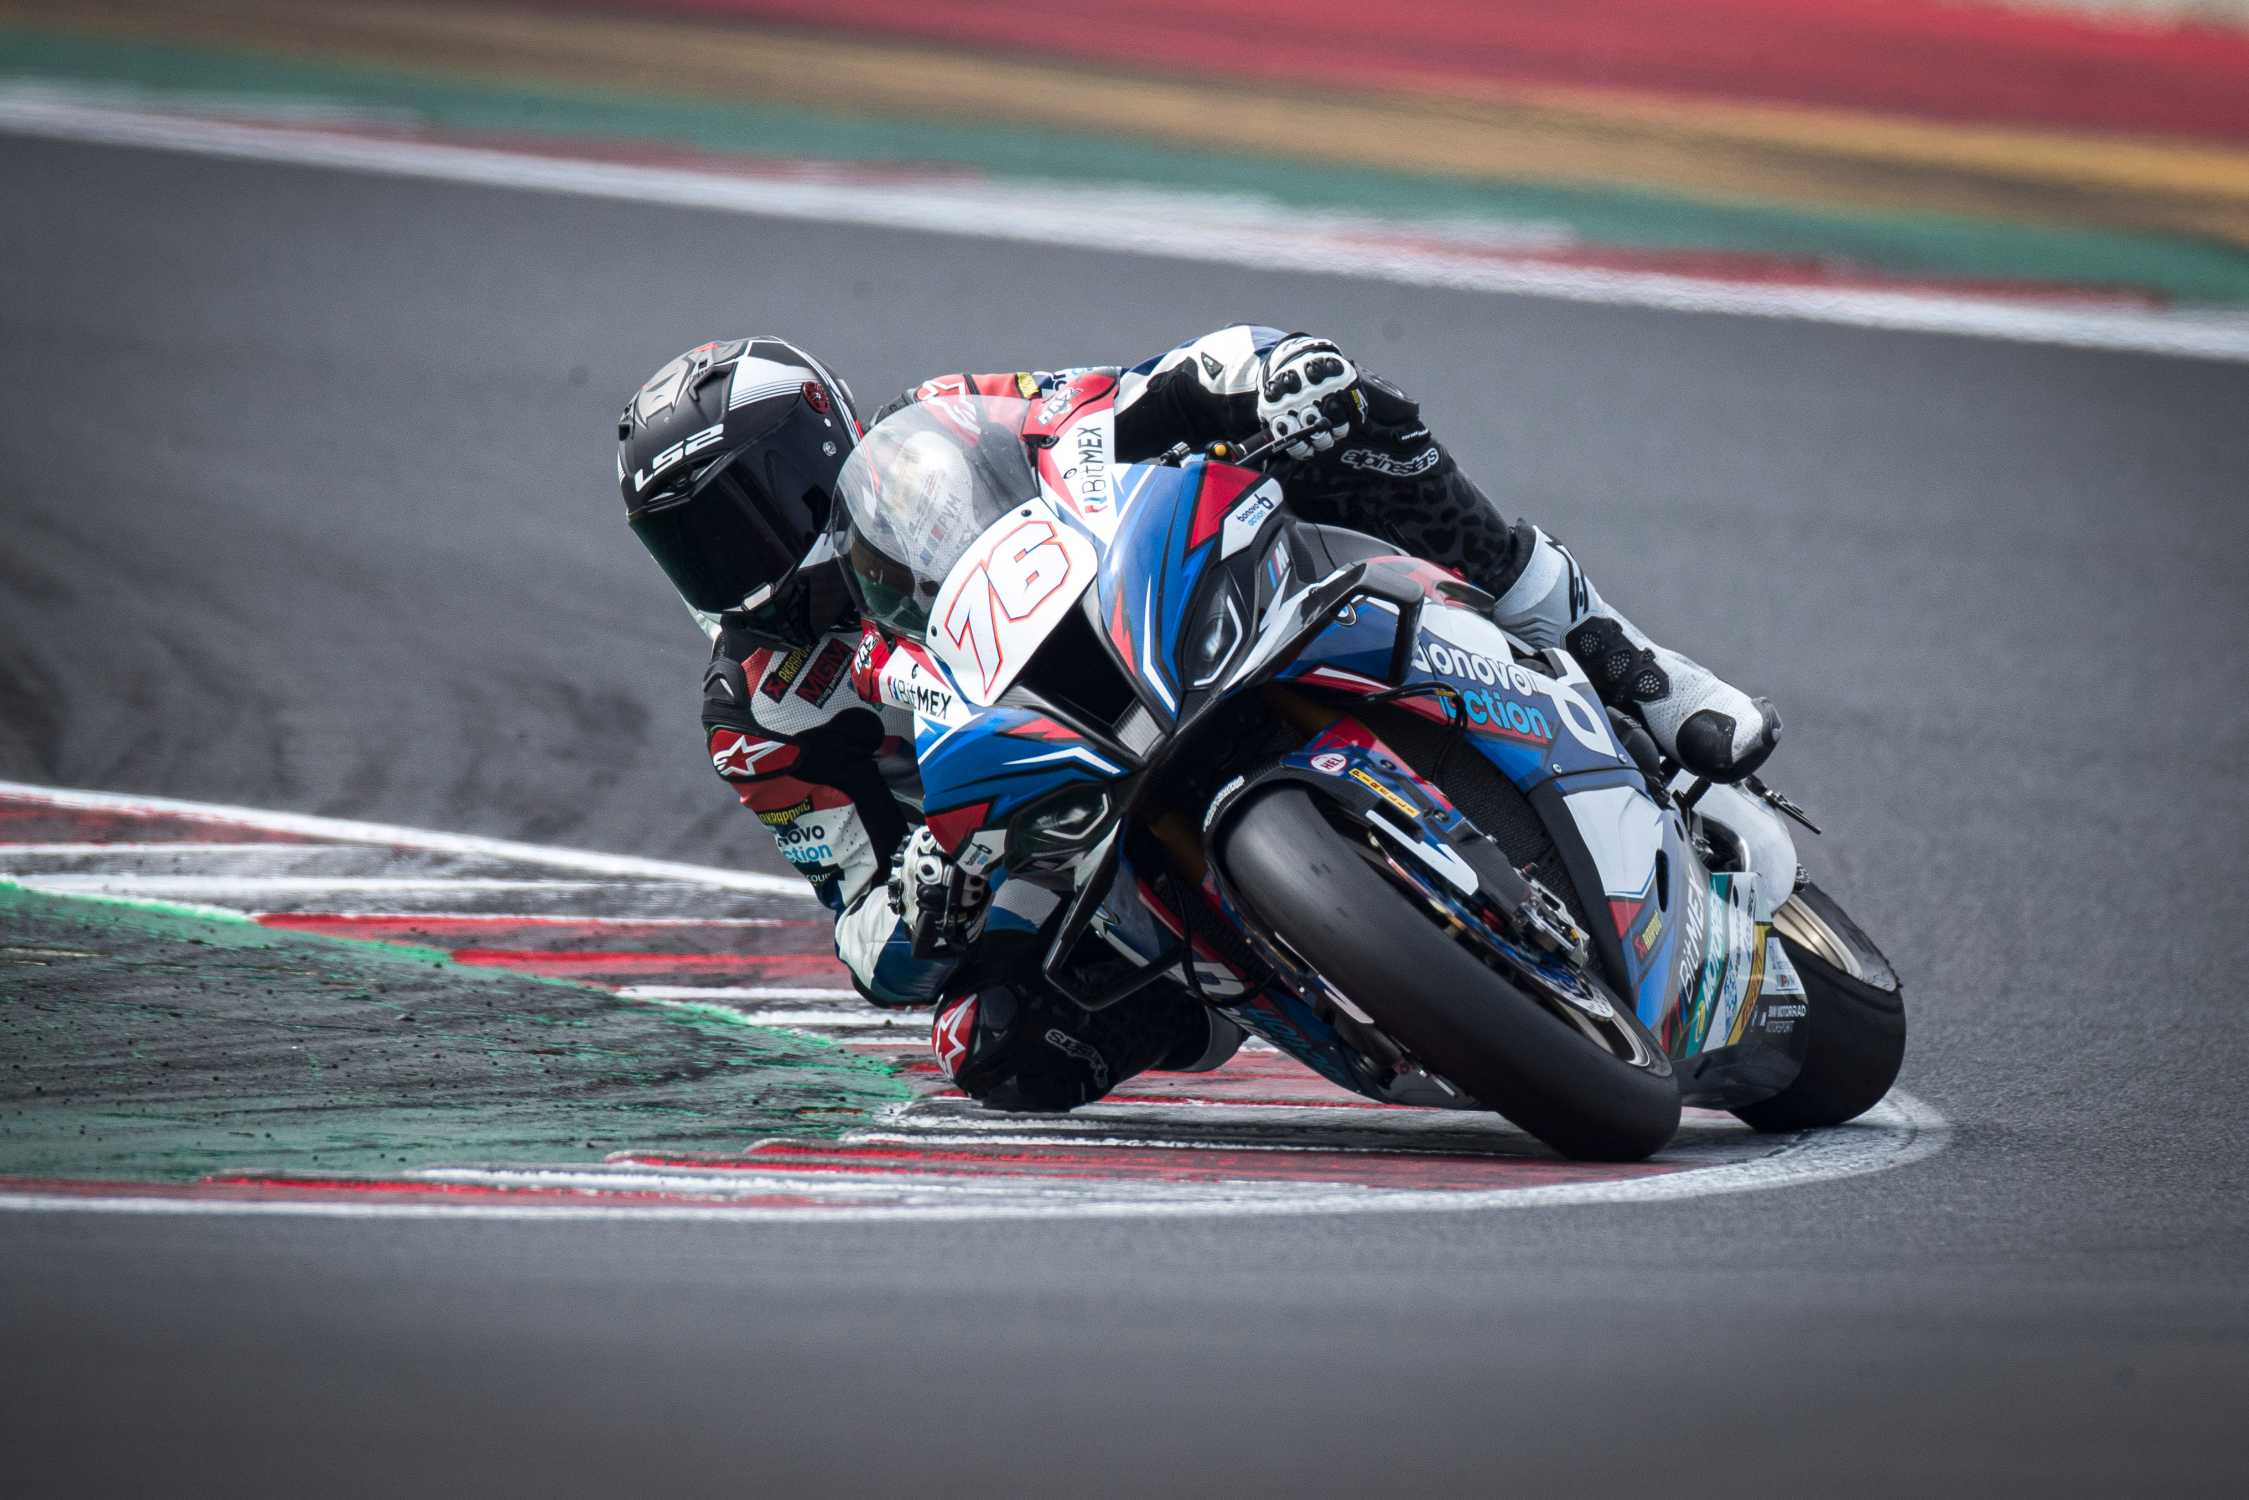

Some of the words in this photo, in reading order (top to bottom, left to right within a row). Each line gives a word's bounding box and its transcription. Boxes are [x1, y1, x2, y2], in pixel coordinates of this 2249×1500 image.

[634, 424, 724, 492] LS2
[1077, 427, 1107, 495] BitMEX
[944, 520, 1071, 700] 76
[898, 679, 952, 720] BitMEX
[1352, 770, 1416, 815] PIRELLI
